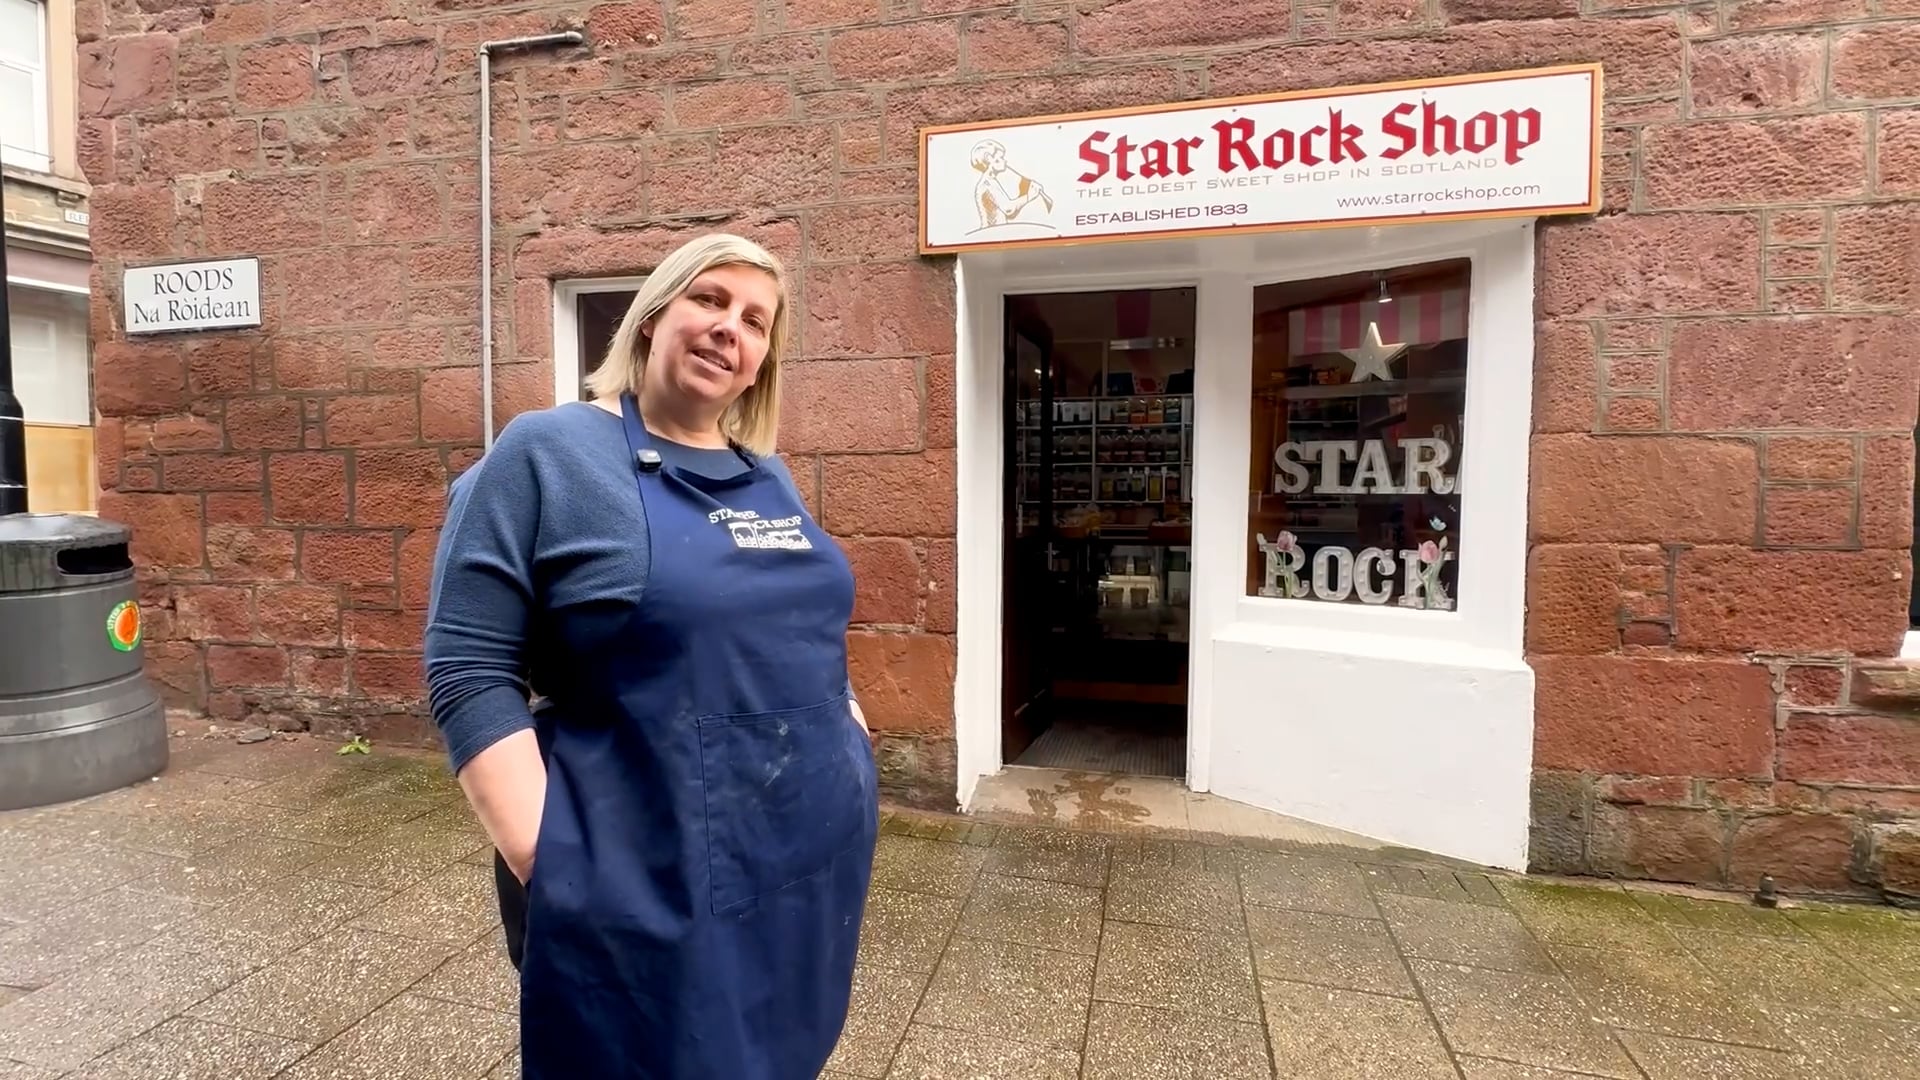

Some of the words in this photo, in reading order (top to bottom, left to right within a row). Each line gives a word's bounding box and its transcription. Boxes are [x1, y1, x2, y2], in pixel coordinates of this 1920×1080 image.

[1077, 130, 1205, 184] Star
[1211, 106, 1368, 173] Rock
[1379, 98, 1542, 166] Shop
[1076, 187, 1113, 199] THE
[1121, 180, 1198, 196] OLDEST
[1206, 174, 1273, 190] SWEET
[1282, 169, 1341, 184] SHOP
[1350, 167, 1371, 179] IN
[1380, 157, 1499, 177] SCOTLAND
[1336, 183, 1542, 209] www.starrockshop.com
[1075, 206, 1201, 226] ESTABLISHED
[1203, 203, 1249, 217] 1833
[153, 267, 234, 295] ROODS
[134, 303, 161, 324] Na
[168, 296, 251, 321] Ròidean
[1274, 437, 1456, 495] STAR
[1258, 542, 1456, 609] ROCK
